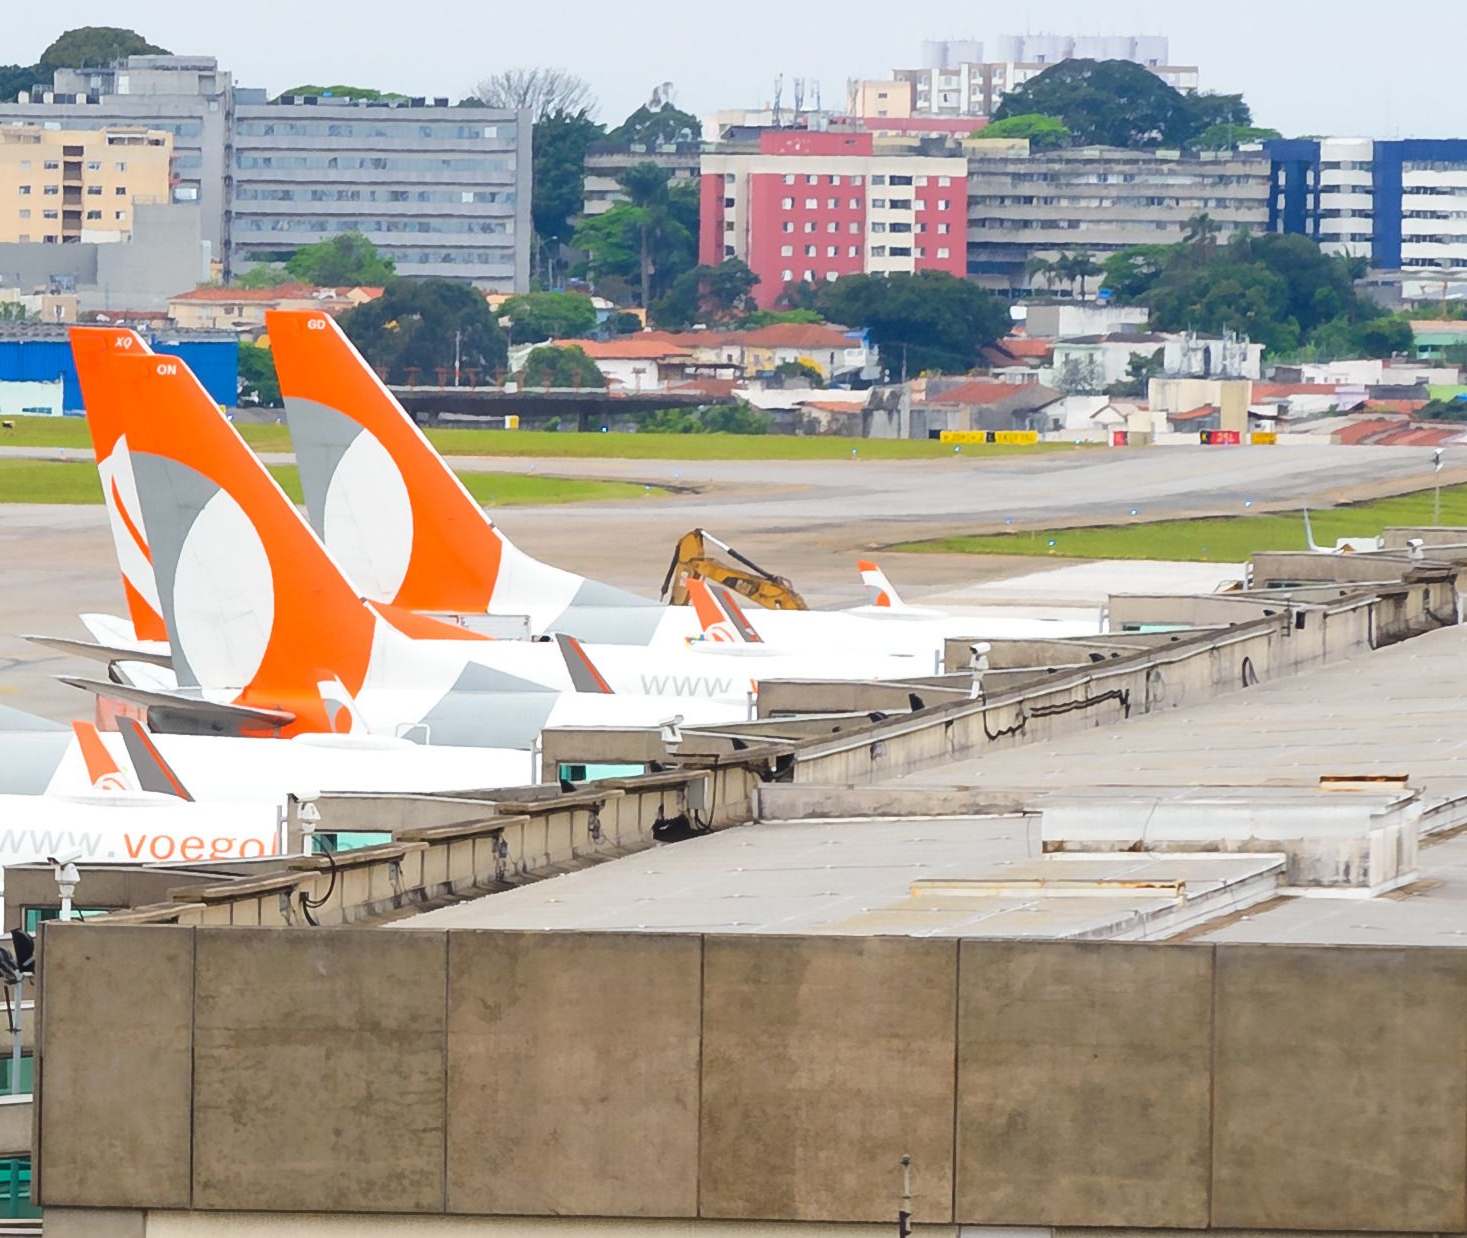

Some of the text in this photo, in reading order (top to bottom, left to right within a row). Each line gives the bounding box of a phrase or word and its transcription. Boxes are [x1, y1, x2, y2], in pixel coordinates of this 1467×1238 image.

[307, 318, 326, 330] GD
[115, 336, 133, 350] XQ
[156, 364, 177, 376] ON
